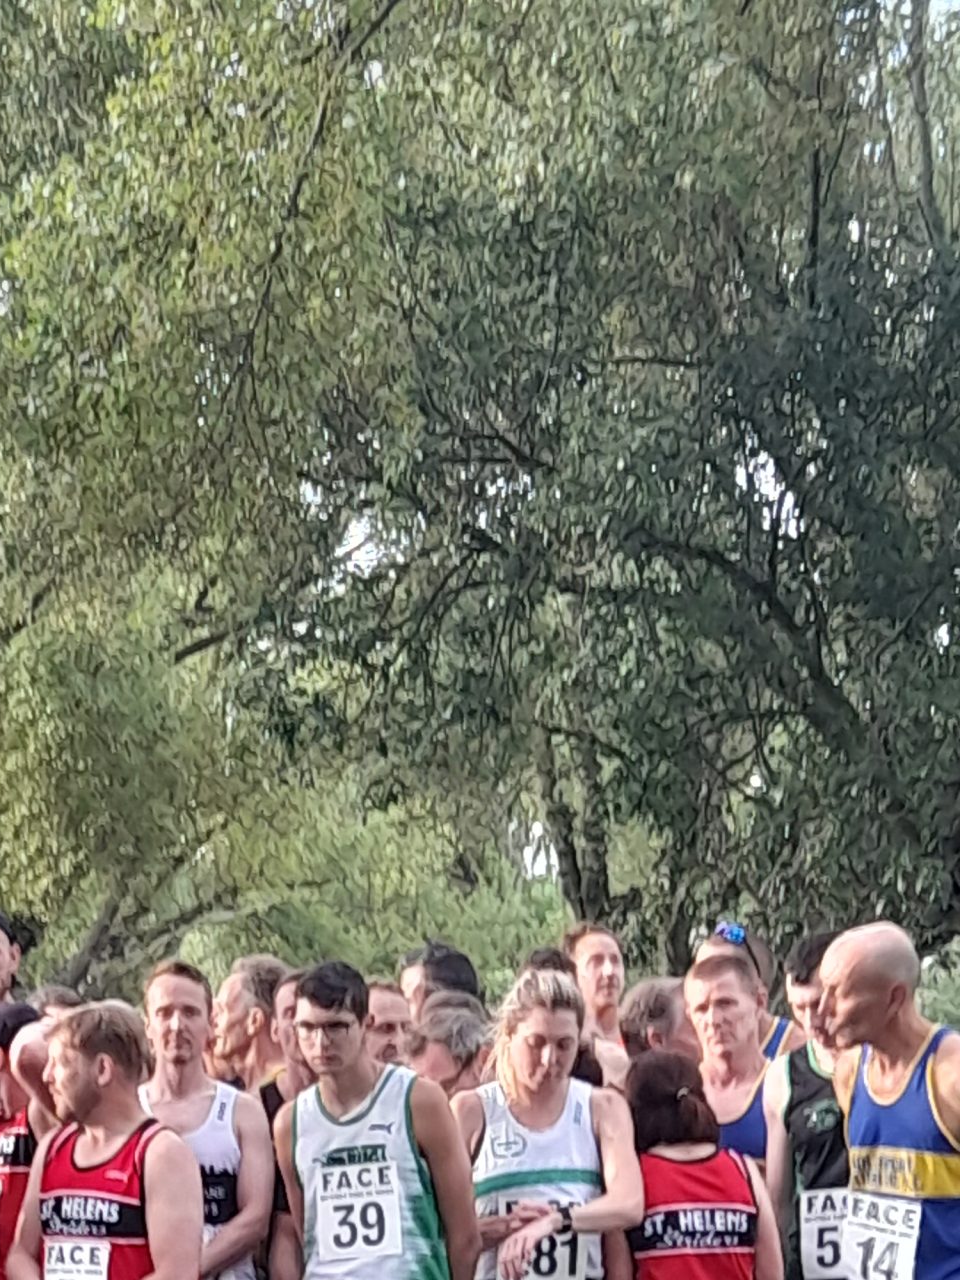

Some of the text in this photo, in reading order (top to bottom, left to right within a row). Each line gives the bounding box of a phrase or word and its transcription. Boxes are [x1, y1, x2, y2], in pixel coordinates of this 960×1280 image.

[61, 1196, 119, 1223] HELENS
[333, 1201, 386, 1249] 39
[679, 1209, 748, 1233] HELENS
[525, 1232, 578, 1277] 81
[817, 1225, 841, 1268] 5
